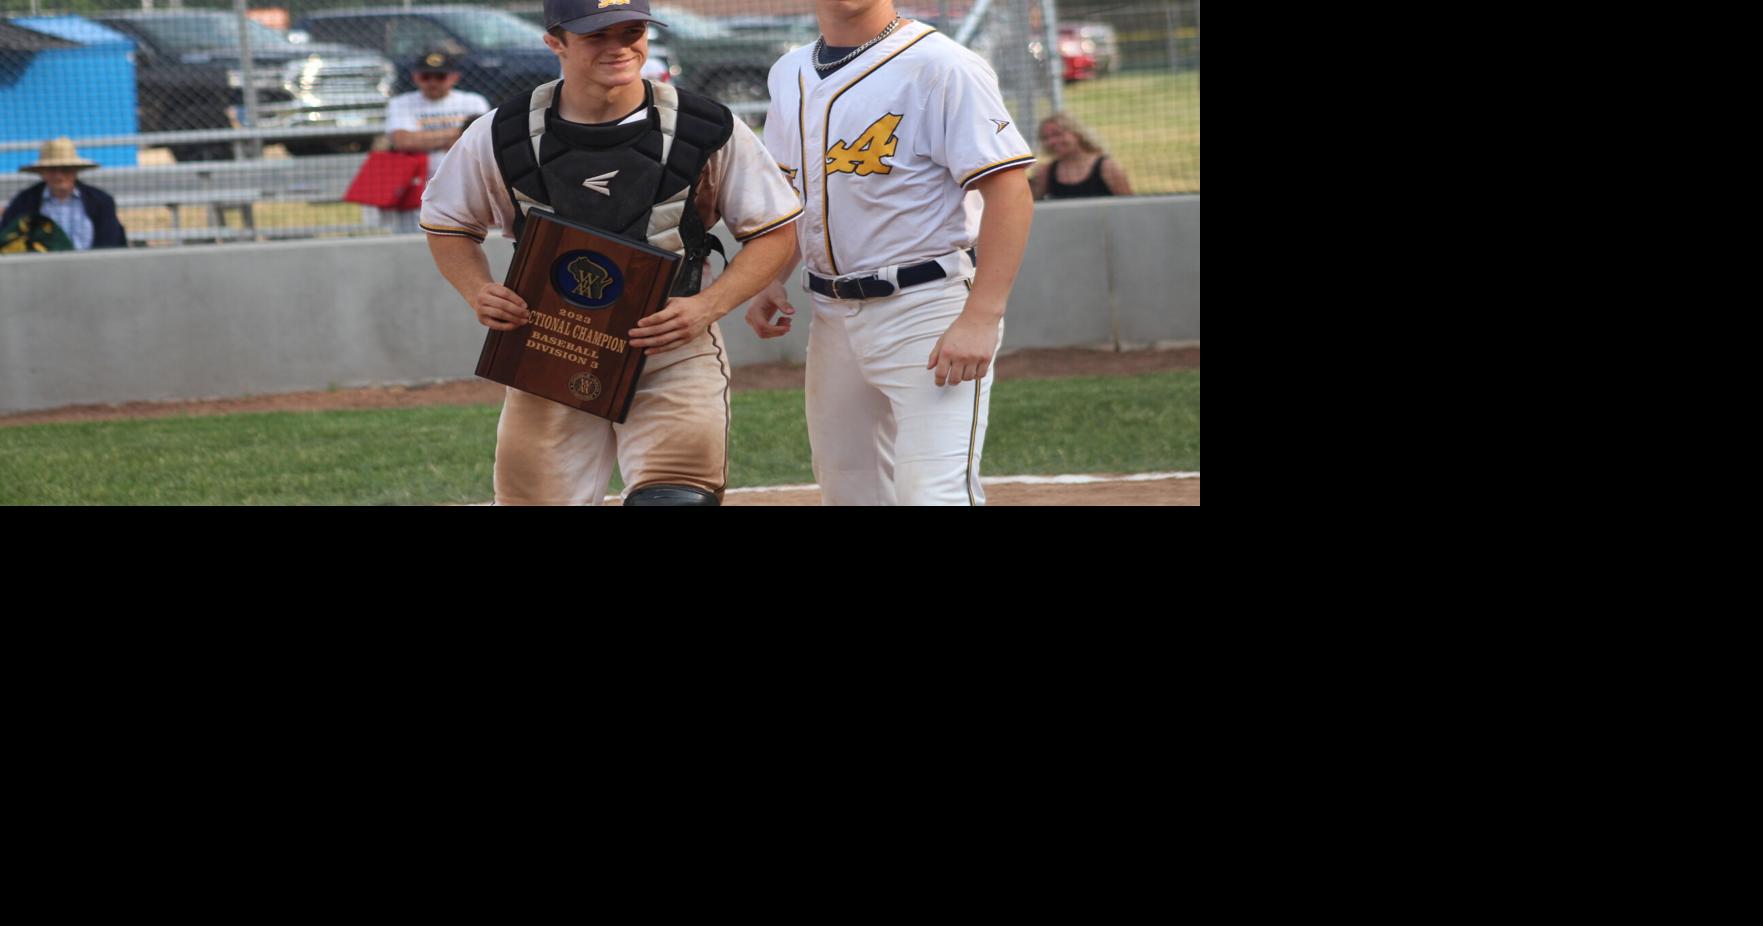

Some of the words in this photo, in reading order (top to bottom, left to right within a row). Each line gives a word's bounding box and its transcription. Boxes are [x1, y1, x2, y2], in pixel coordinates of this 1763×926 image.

[559, 308, 592, 325] 2023
[528, 310, 571, 336] CTIONAL
[572, 324, 626, 354] CHAMPION
[531, 330, 599, 359] BASEBALL
[526, 339, 588, 365] DIVISION
[590, 360, 599, 369] 3
